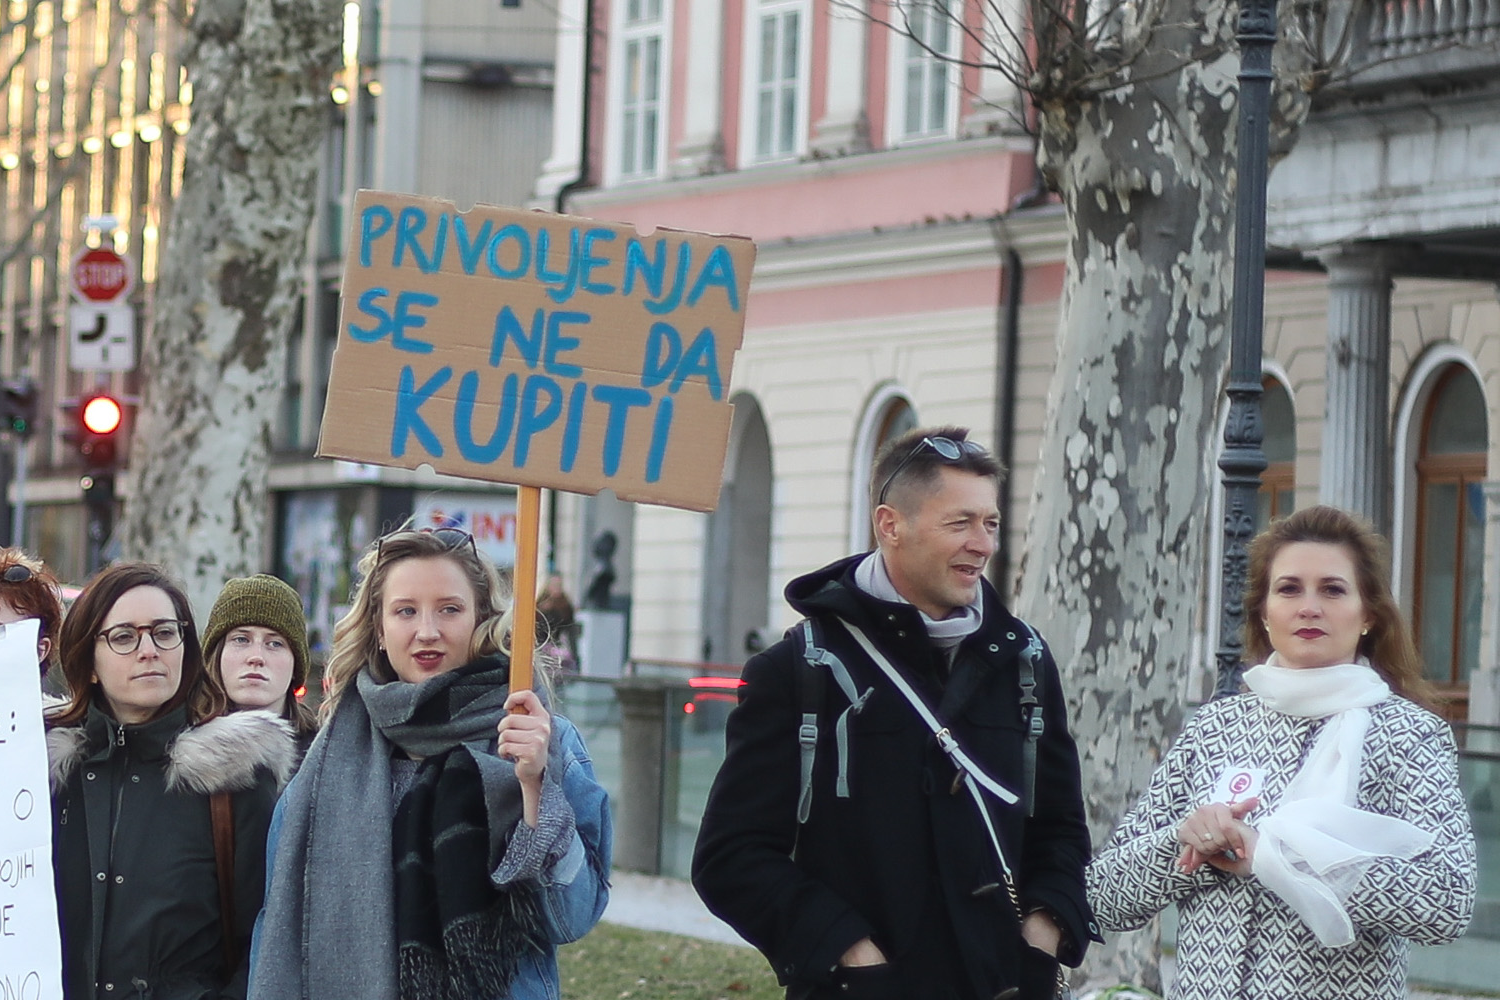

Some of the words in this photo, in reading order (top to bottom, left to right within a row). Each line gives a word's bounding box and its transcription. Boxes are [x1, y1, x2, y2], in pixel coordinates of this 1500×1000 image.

[77, 262, 126, 286] STOP
[359, 205, 740, 315] PRIVOLJENJA
[347, 286, 440, 353] SE
[488, 305, 591, 378] NE
[639, 321, 724, 401] DA
[390, 364, 674, 483] KUPITI
[13, 788, 34, 820] O
